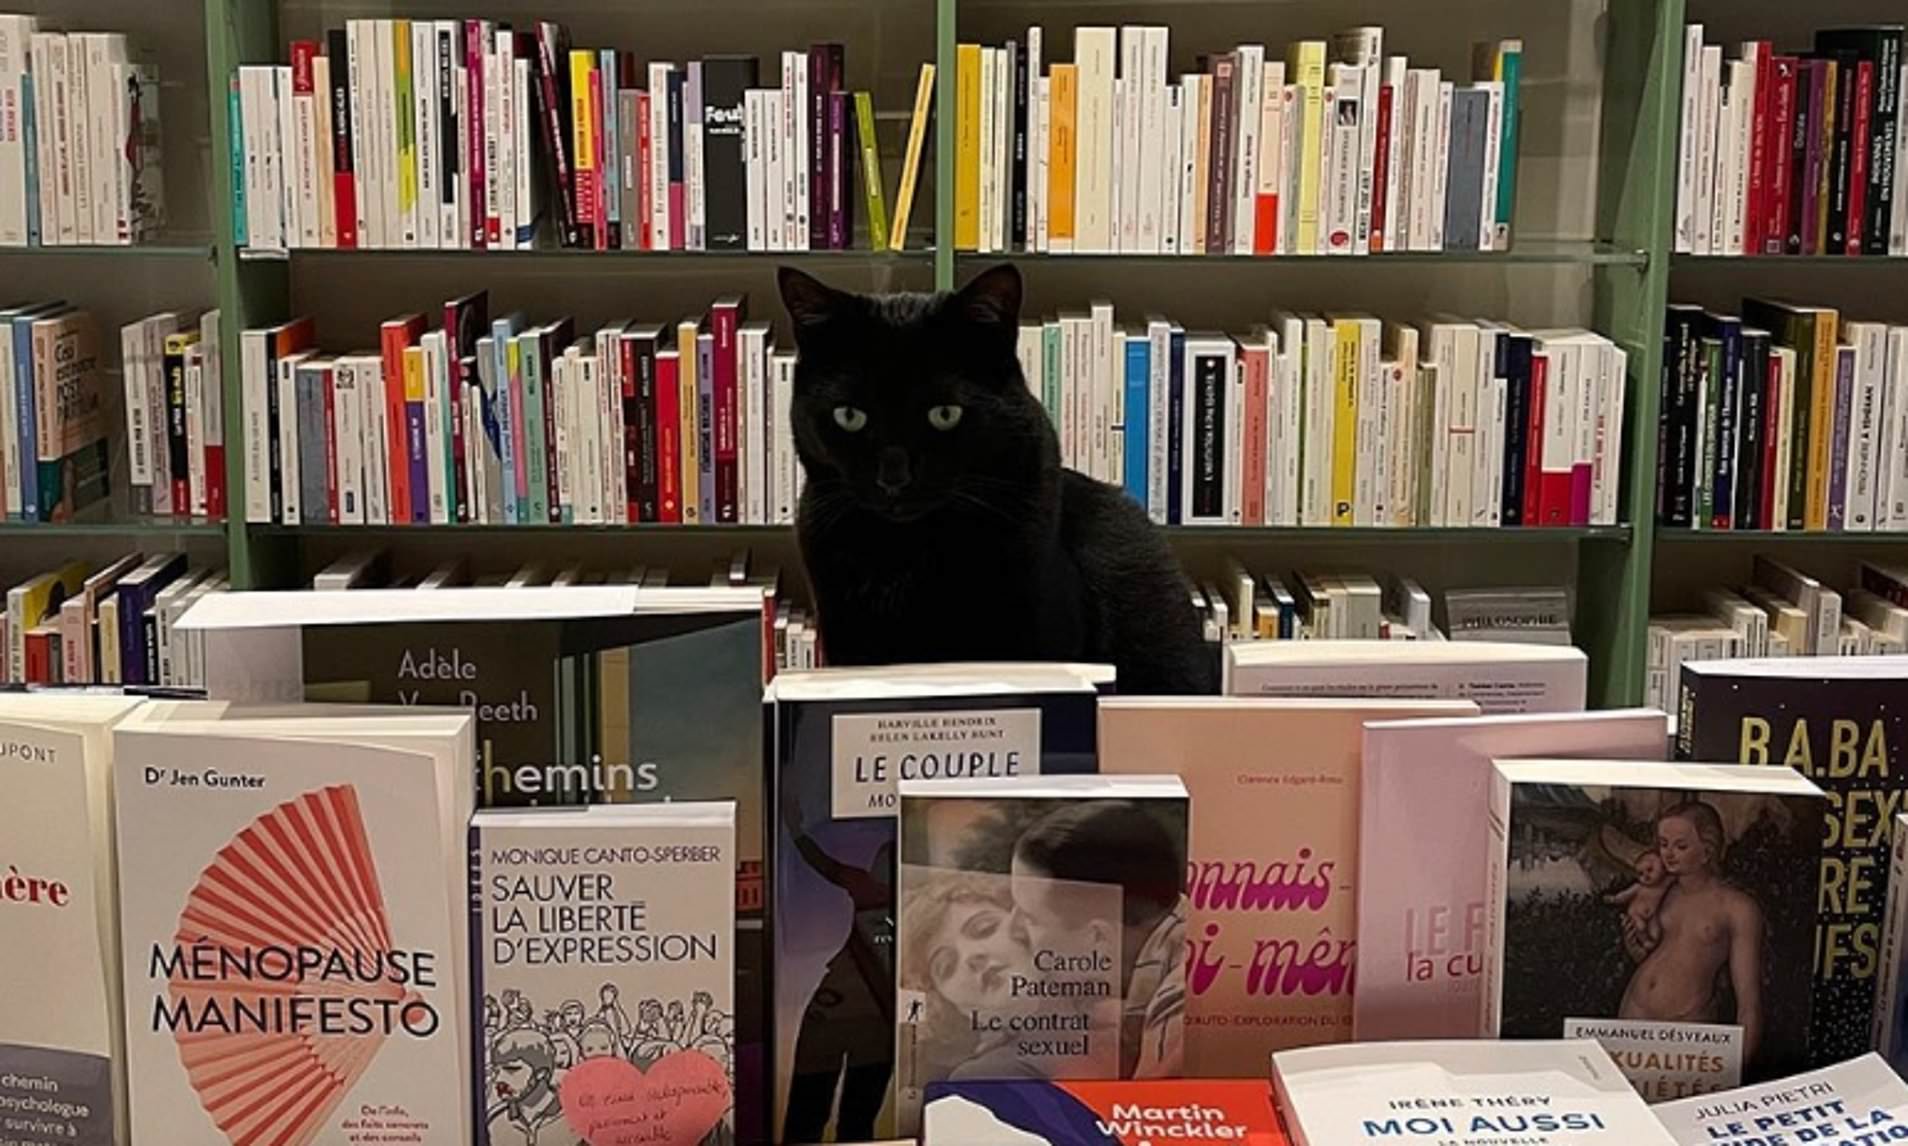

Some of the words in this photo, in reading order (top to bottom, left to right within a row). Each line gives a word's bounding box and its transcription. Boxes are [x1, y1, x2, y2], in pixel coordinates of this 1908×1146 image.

[398, 648, 477, 680] Adèle
[878, 718, 939, 729] HARVILLE
[943, 717, 997, 727] HENDRIX
[170, 769, 202, 789] Jen
[205, 771, 266, 789] Gunter
[476, 739, 660, 793] hemins
[855, 755, 888, 783] LE
[900, 752, 1020, 780] COUPLE
[491, 848, 580, 866] MONIQUE
[584, 845, 721, 863] CANTO-SPERBER
[0, 865, 70, 907] ère
[491, 873, 614, 902] SAUVER
[493, 906, 528, 934] LA
[539, 900, 647, 933] LIBERTÉ
[149, 935, 438, 987] MÉNOPAUSE
[494, 934, 717, 964] D'EXPRESSION
[1034, 950, 1112, 972] Carole
[1406, 951, 1434, 982] la
[1011, 976, 1111, 997] Pateman
[151, 993, 440, 1038] MANIFESTO
[971, 1010, 1001, 1031] Le
[1010, 1012, 1089, 1032] contrat
[1017, 1036, 1089, 1056] sexuel
[1575, 1026, 1654, 1041] EMMANUEL
[1659, 1028, 1732, 1044] DÉSVEAUX
[1, 1073, 59, 1093] chemin
[1112, 1103, 1225, 1122] Martin
[1388, 1097, 1465, 1111] IRÈNE
[1471, 1094, 1552, 1108] THÉRY
[1695, 1100, 1758, 1121] JULIA
[1761, 1080, 1836, 1109] PIETRI
[5, 1117, 65, 1135] survivre
[1096, 1120, 1248, 1138] Winckler
[1362, 1116, 1453, 1138] MOI
[1470, 1112, 1606, 1133] AUSSI
[1706, 1122, 1751, 1140] LE
[1753, 1099, 1846, 1135] PETIT
[1794, 1121, 1840, 1143] DE
[1845, 1108, 1894, 1131] LA
